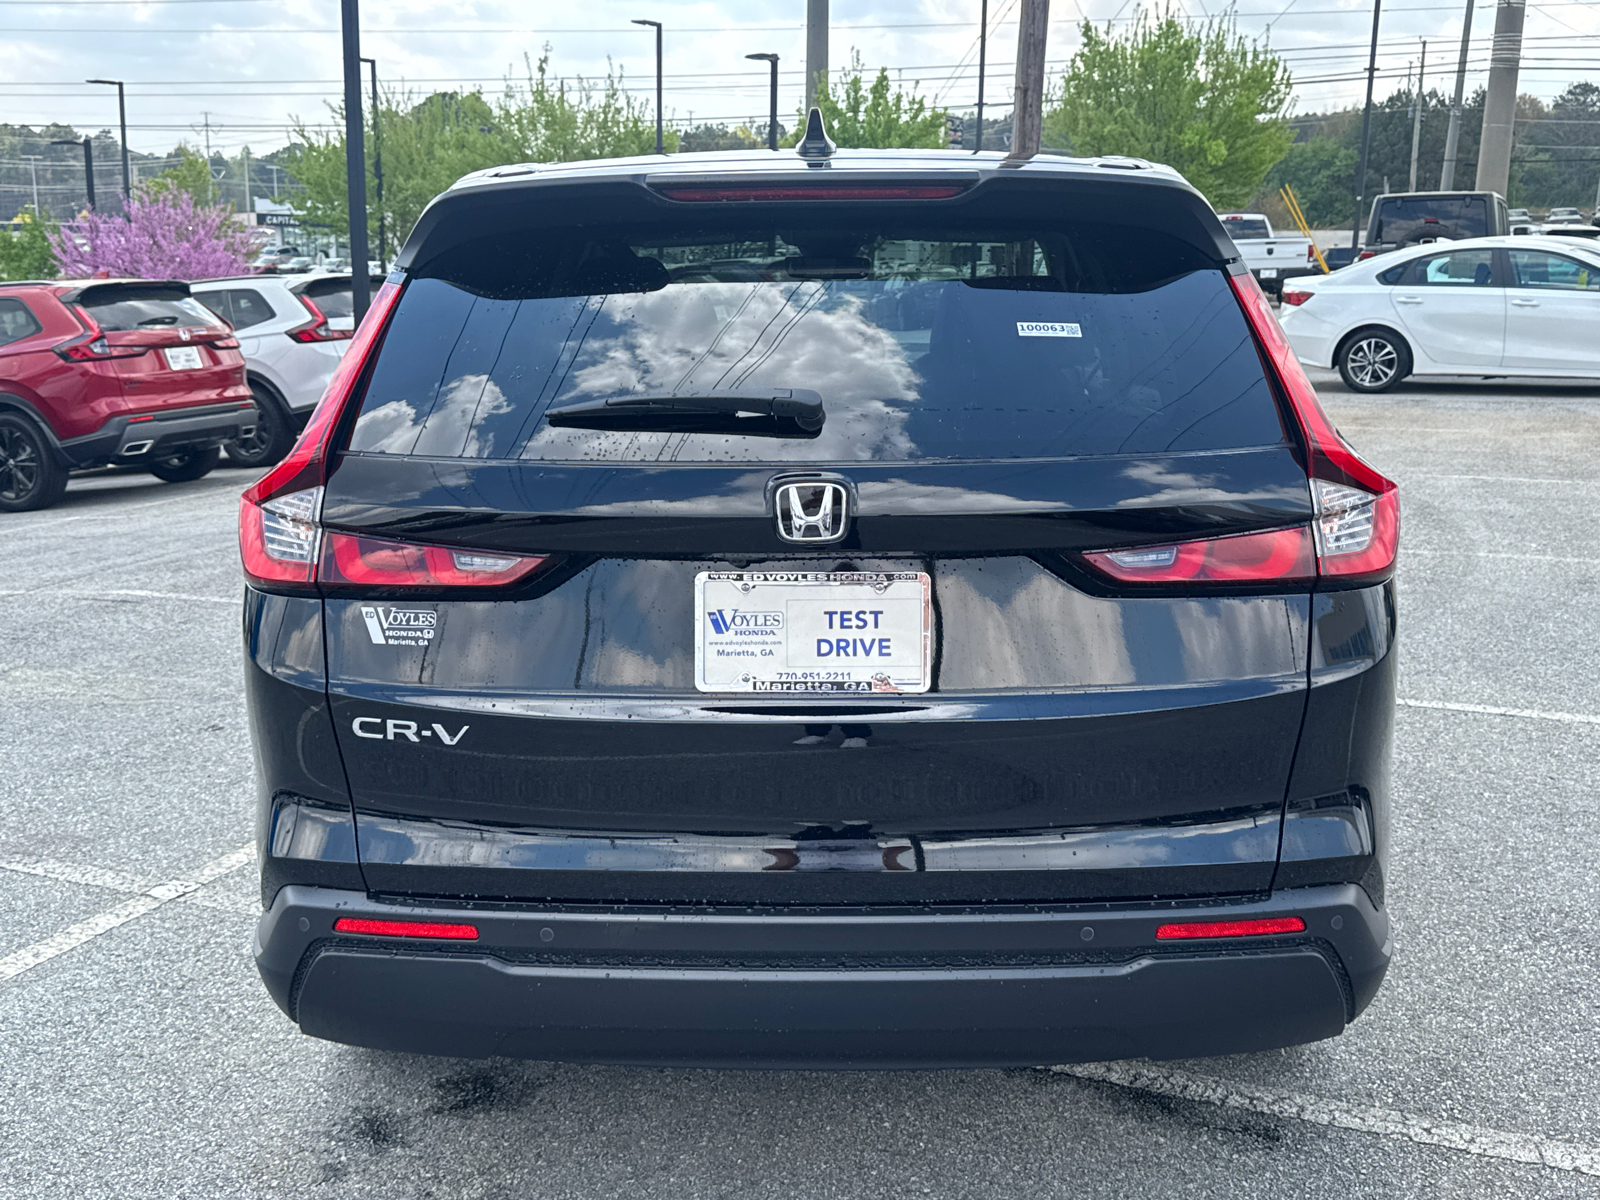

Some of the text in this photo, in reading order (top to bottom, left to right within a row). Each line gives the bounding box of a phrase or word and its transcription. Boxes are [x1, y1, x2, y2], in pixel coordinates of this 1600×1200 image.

[1019, 324, 1065, 332] 100063
[377, 607, 435, 629] VOYLES
[717, 609, 781, 632] VOYLES
[823, 610, 884, 630] TEST
[388, 638, 417, 646] Marietta,
[816, 638, 892, 657] DRIVE
[716, 649, 775, 658] Marietta, GA
[776, 672, 851, 680] 770-951-2211
[755, 681, 870, 691] Marietta, GA
[351, 716, 470, 746] CR-V
